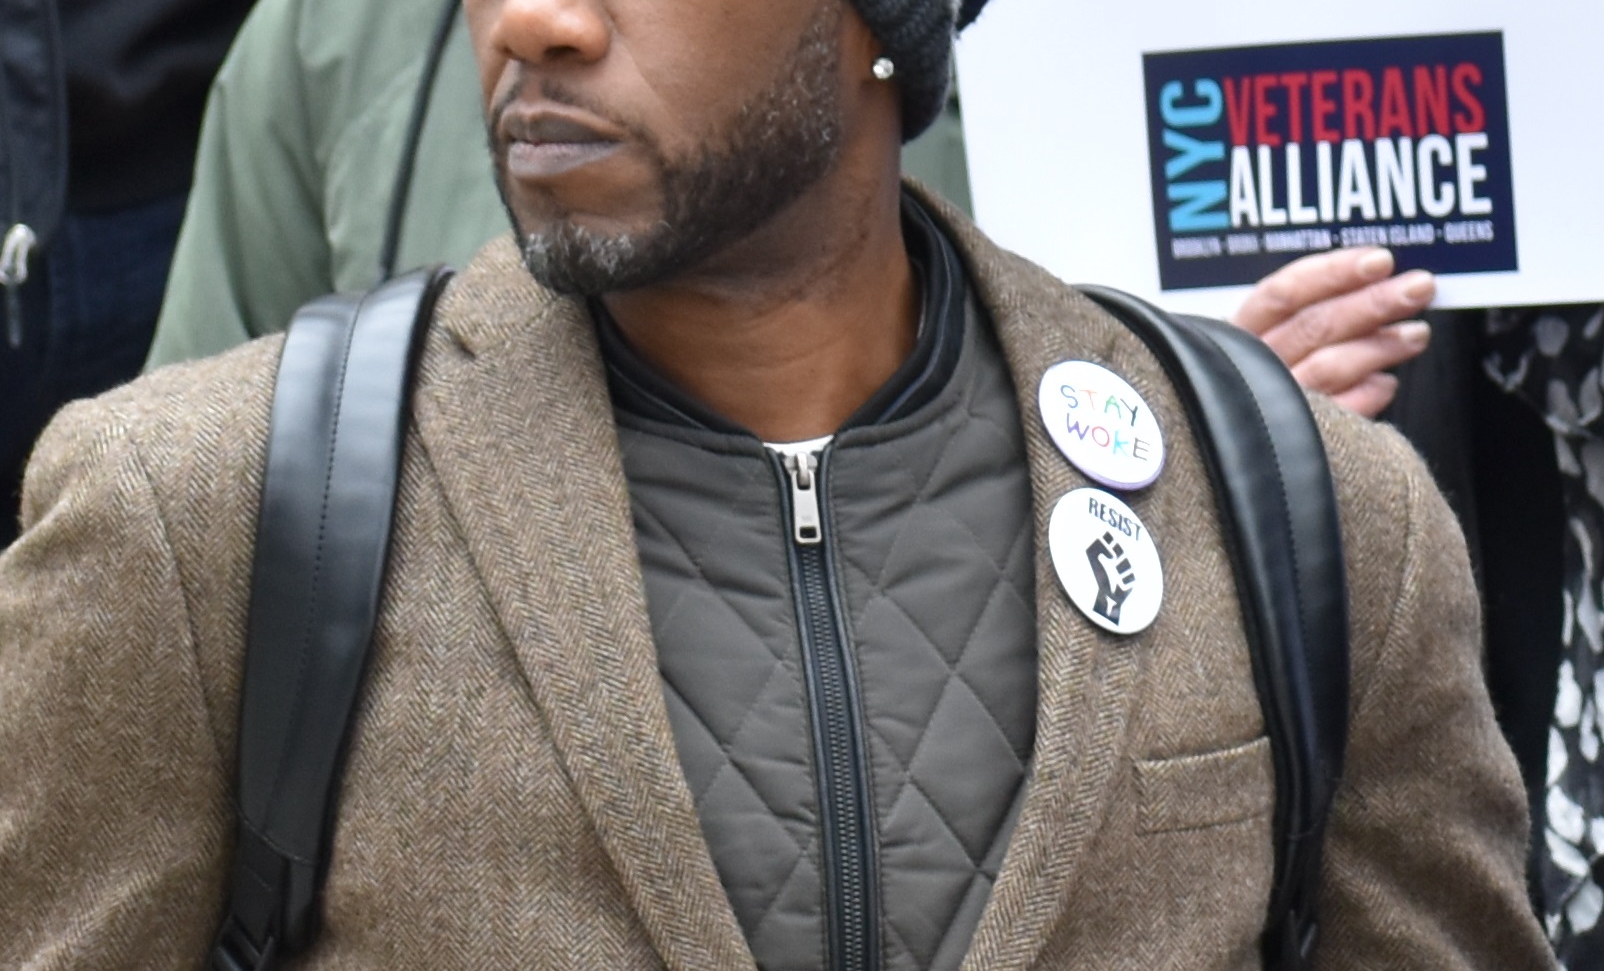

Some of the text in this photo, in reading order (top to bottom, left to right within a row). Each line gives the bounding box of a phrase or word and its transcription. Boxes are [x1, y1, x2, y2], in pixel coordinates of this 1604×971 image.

[1223, 62, 1487, 147] VETERANS
[1159, 77, 1232, 232] NYC
[1230, 132, 1493, 228] ALLIANCE
[1060, 384, 1139, 427] STAY
[1066, 412, 1151, 461] WOKE
[1088, 496, 1141, 541] RESIST
